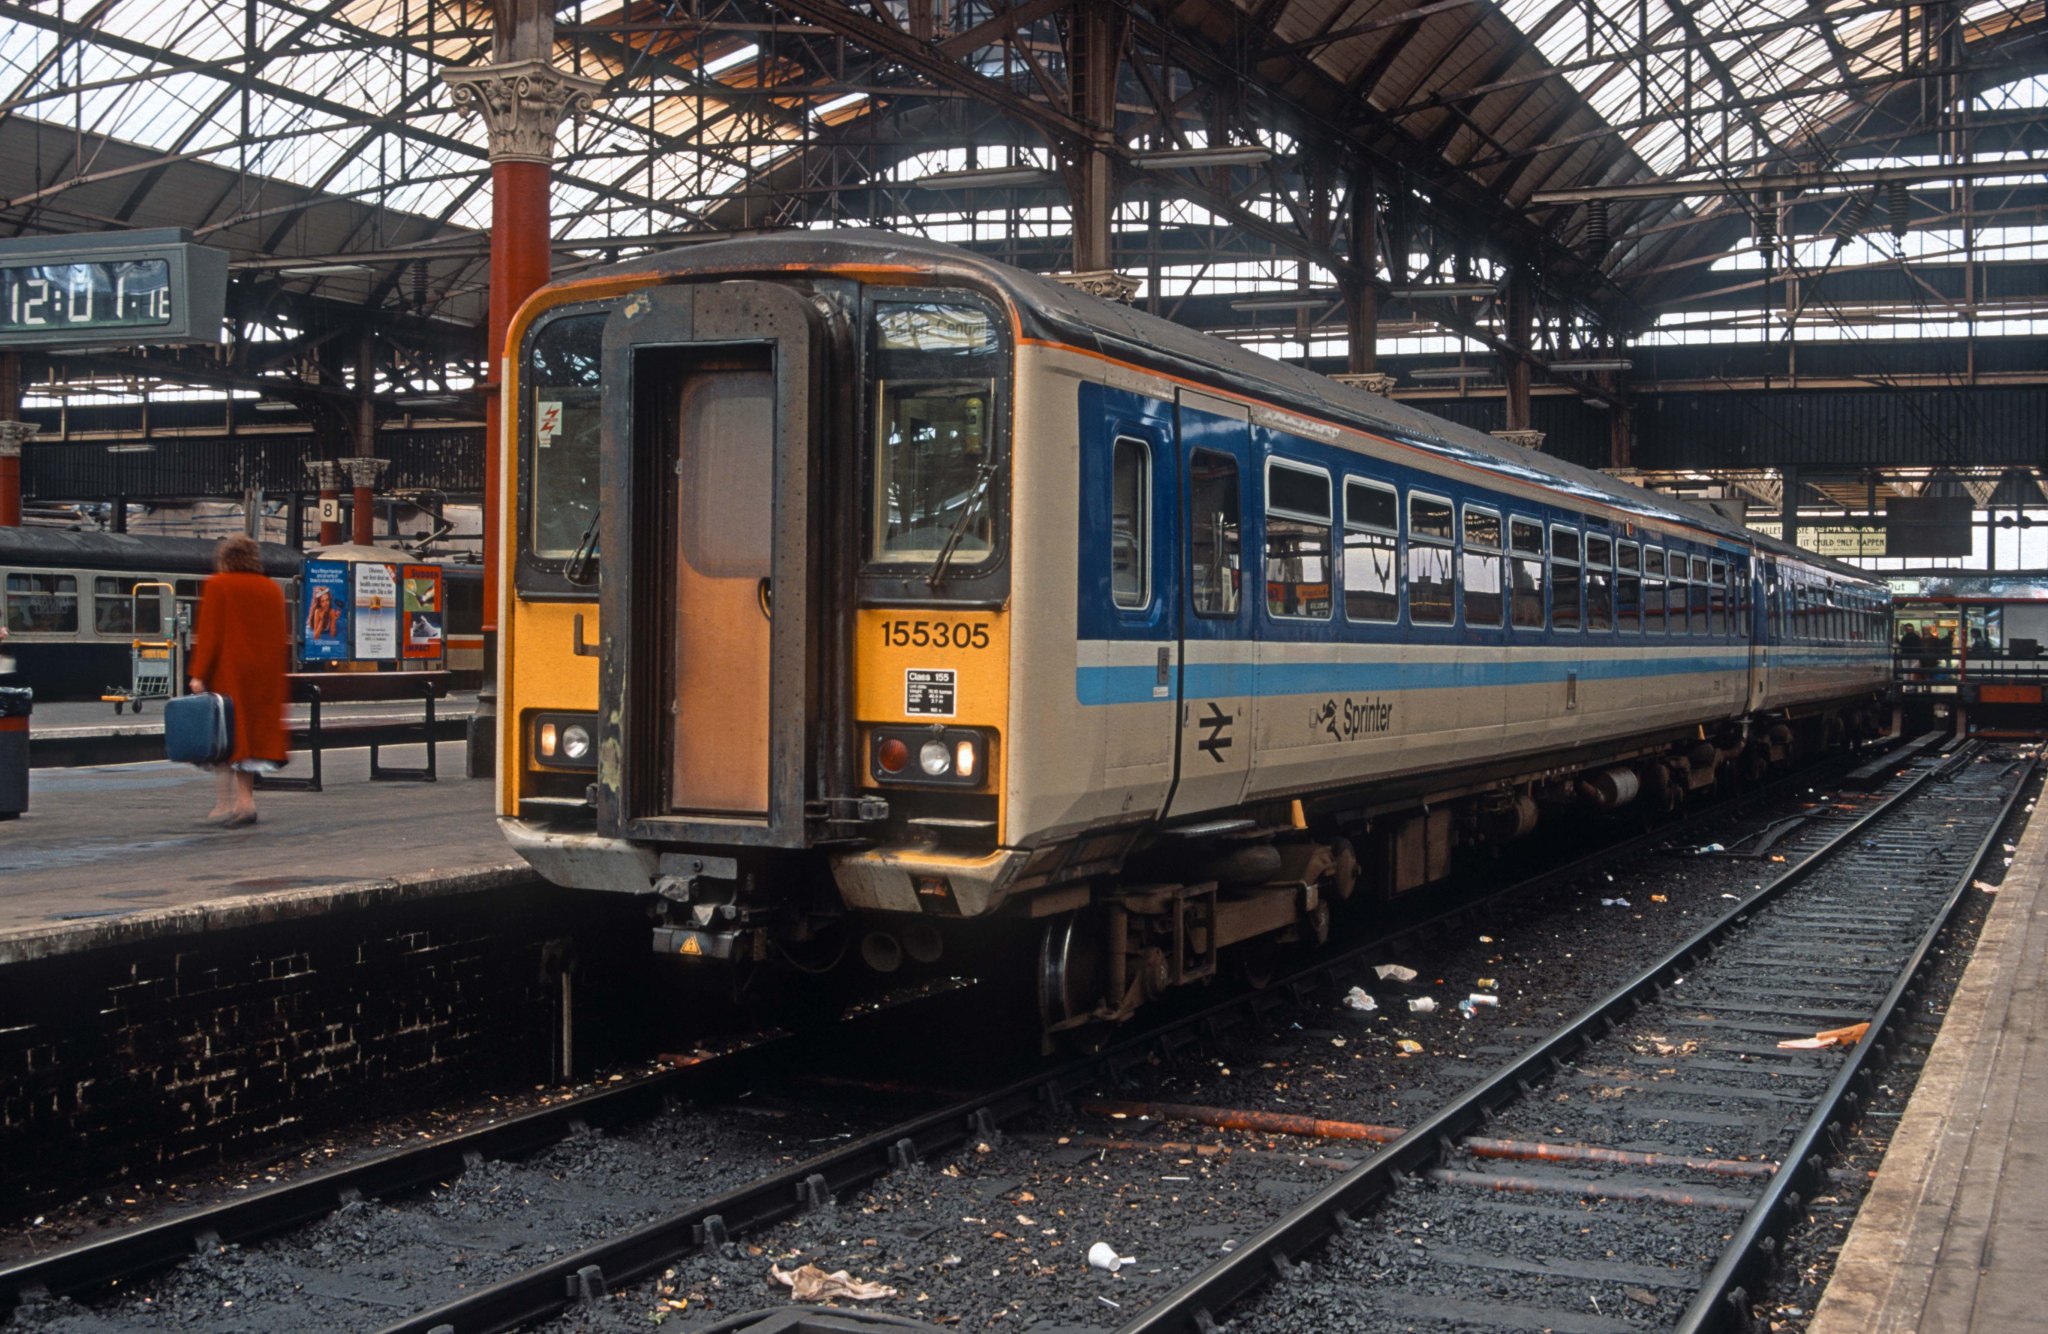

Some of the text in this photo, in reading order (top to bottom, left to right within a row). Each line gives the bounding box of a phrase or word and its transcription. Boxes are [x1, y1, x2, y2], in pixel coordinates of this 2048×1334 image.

[937, 319, 987, 337] Central
[324, 503, 333, 518] 8
[881, 620, 990, 649] 155305
[909, 672, 950, 682] Class 155
[1344, 696, 1393, 741] Sprinter
